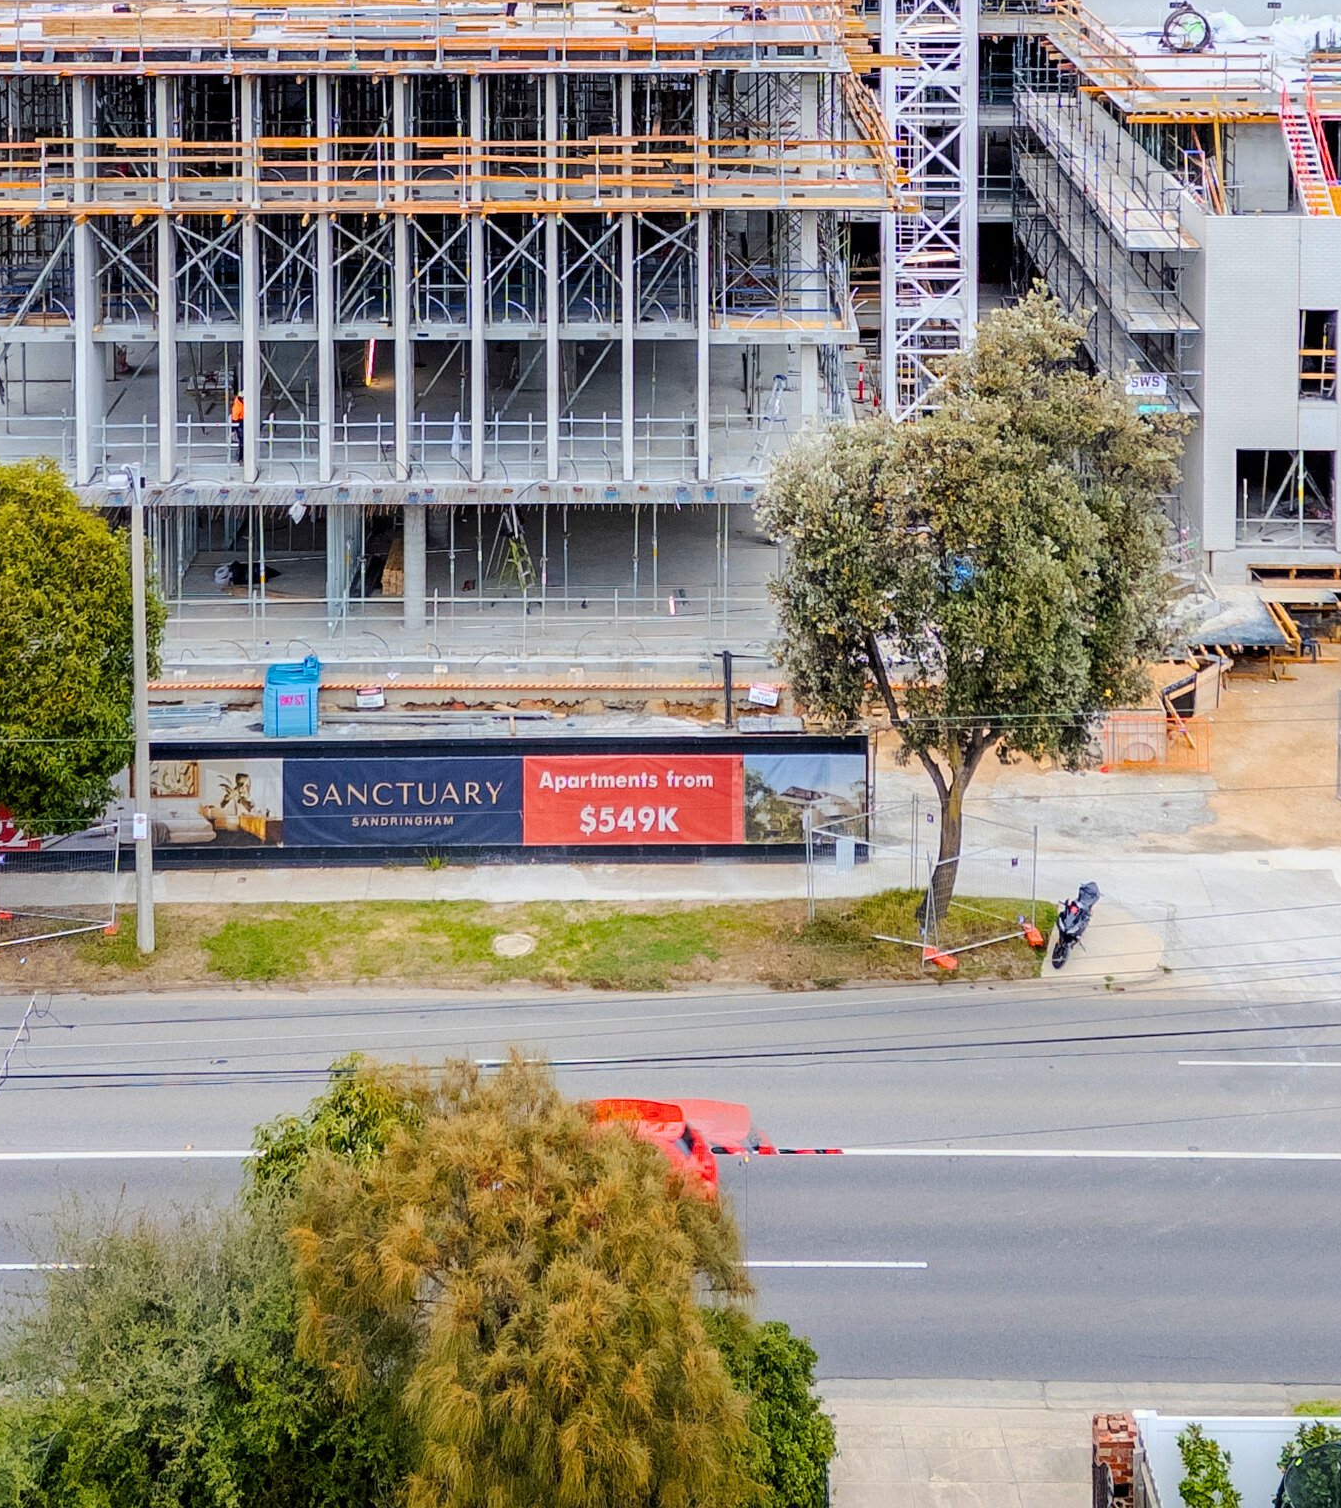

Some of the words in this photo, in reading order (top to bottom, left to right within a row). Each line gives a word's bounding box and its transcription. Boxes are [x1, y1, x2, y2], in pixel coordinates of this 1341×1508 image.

[539, 771, 658, 793] Apartments
[666, 770, 713, 788] from
[302, 781, 503, 807] SANCTUARY
[351, 815, 454, 827] SANDRINGHAM
[580, 803, 679, 837] $549K
